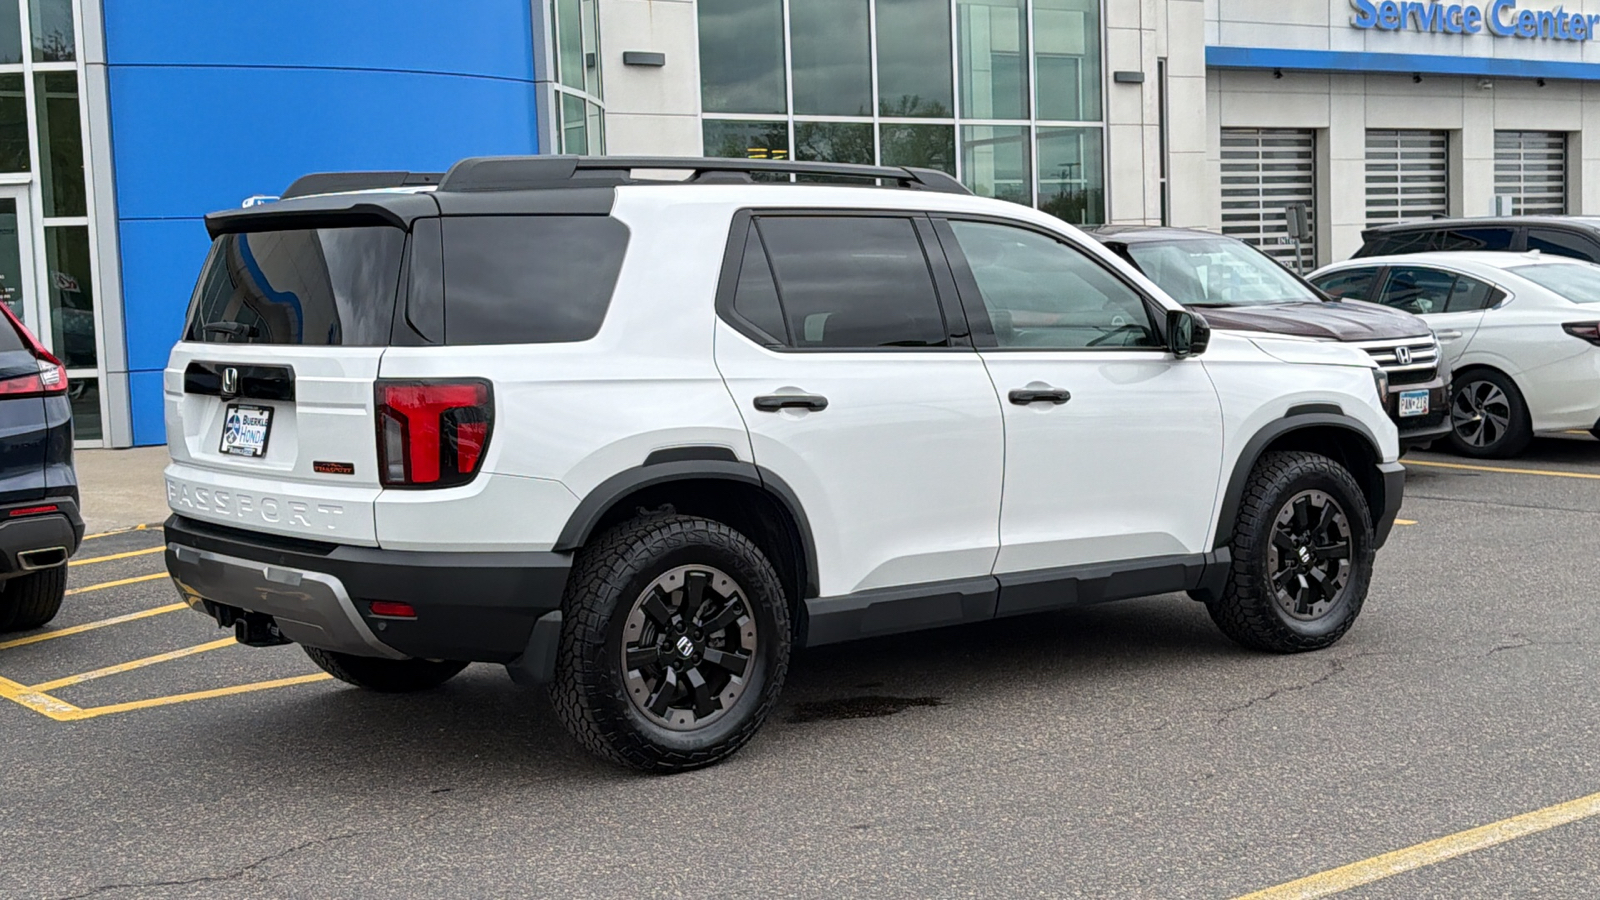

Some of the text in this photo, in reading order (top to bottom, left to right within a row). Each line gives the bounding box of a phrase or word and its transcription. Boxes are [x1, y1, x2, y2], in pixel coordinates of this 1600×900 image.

[1351, 0, 1600, 41] Service Center
[240, 426, 267, 444] HONDA
[166, 479, 343, 530] PASSPORT
